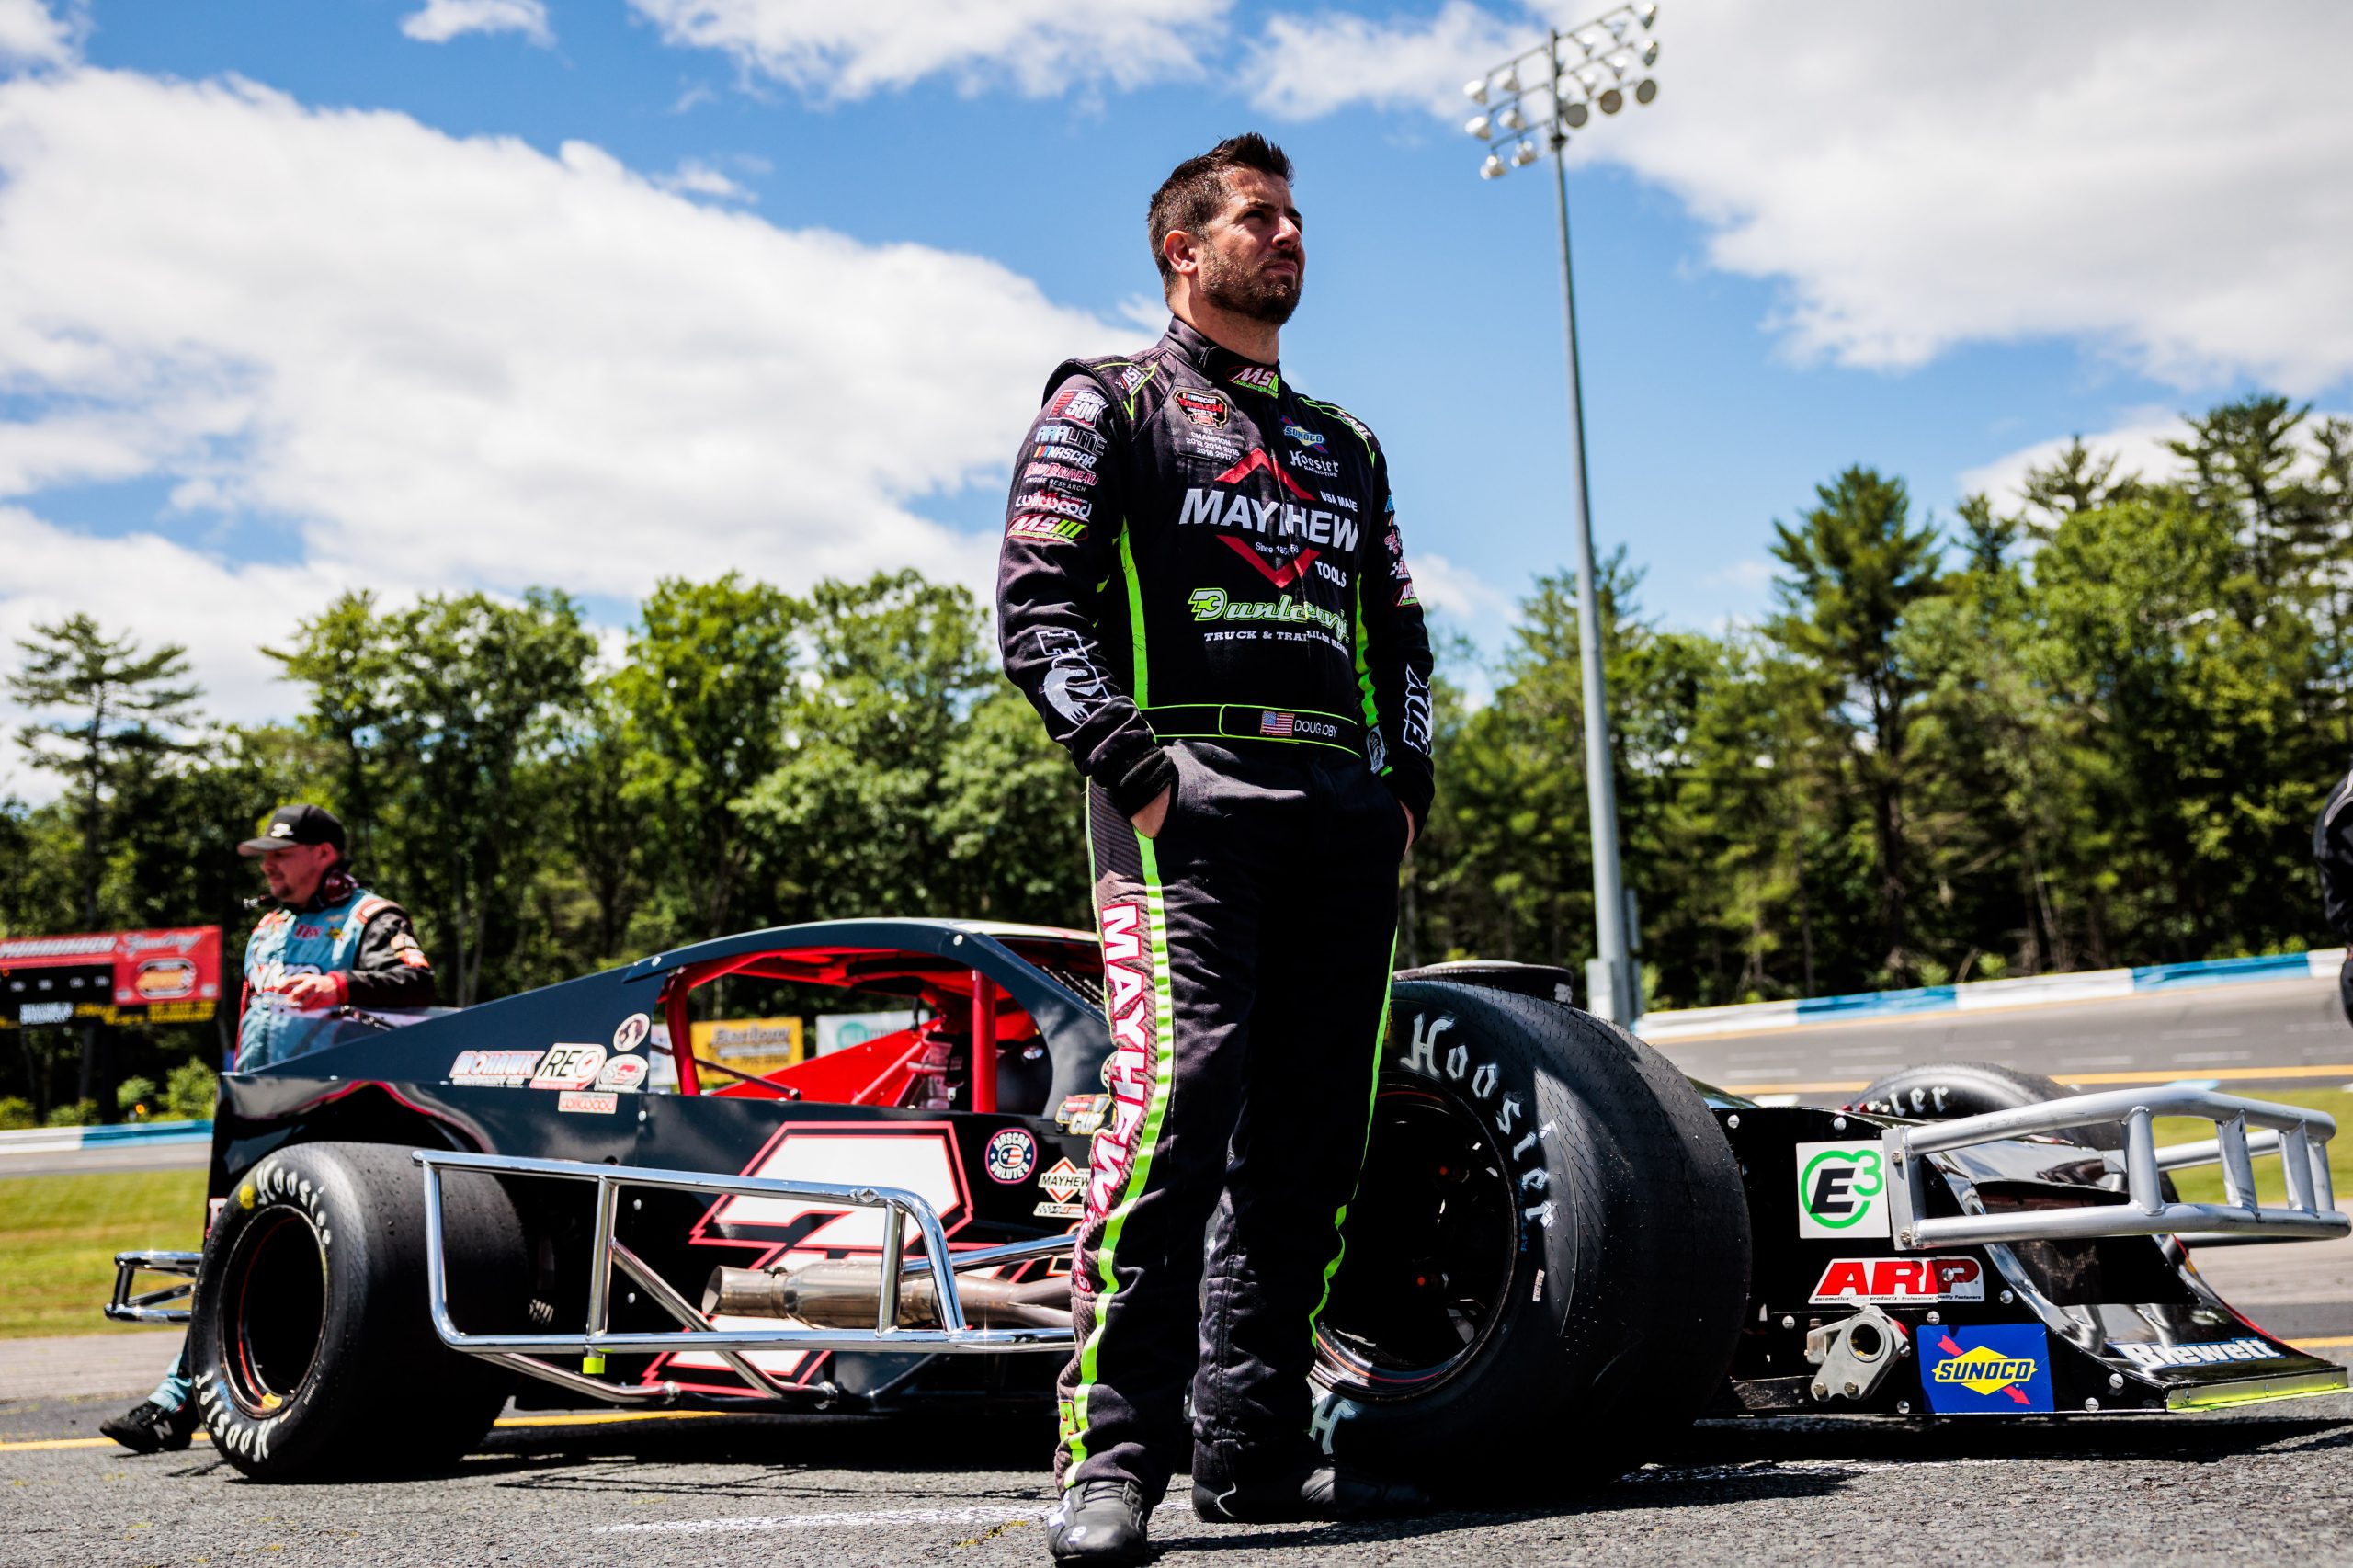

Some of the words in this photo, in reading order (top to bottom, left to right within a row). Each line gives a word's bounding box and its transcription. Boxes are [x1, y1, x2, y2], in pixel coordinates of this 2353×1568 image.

[1190, 393, 1217, 404] NASCAR
[1065, 398, 1101, 423] 500
[1190, 431, 1232, 447] CHAMPION
[1284, 426, 1324, 444] SUNOCO
[1047, 445, 1097, 469] NASCAR
[1289, 449, 1339, 472] Hoosier
[1049, 478, 1087, 493] RESEARCH
[1320, 490, 1337, 506] USA
[1178, 488, 1358, 552] MAYHEW
[1255, 541, 1274, 554] Since
[1314, 560, 1347, 588] TOOLS
[1204, 631, 1257, 642] TRUCK
[1262, 631, 1273, 640] &
[1294, 719, 1321, 735] DOUG
[452, 1051, 542, 1076] MOHAWK
[1071, 1113, 1103, 1135] CUP
[1399, 1012, 1555, 1229] Hoosier
[993, 1132, 1030, 1151] NASCAR
[990, 1161, 1030, 1180] SALUTES
[1040, 1176, 1090, 1187] MAYHEW
[255, 1159, 332, 1246] Hoosier
[1816, 1258, 1980, 1296] ARP
[1938, 1361, 2031, 1380] SUNOCO
[194, 1370, 280, 1463] Hoosier
